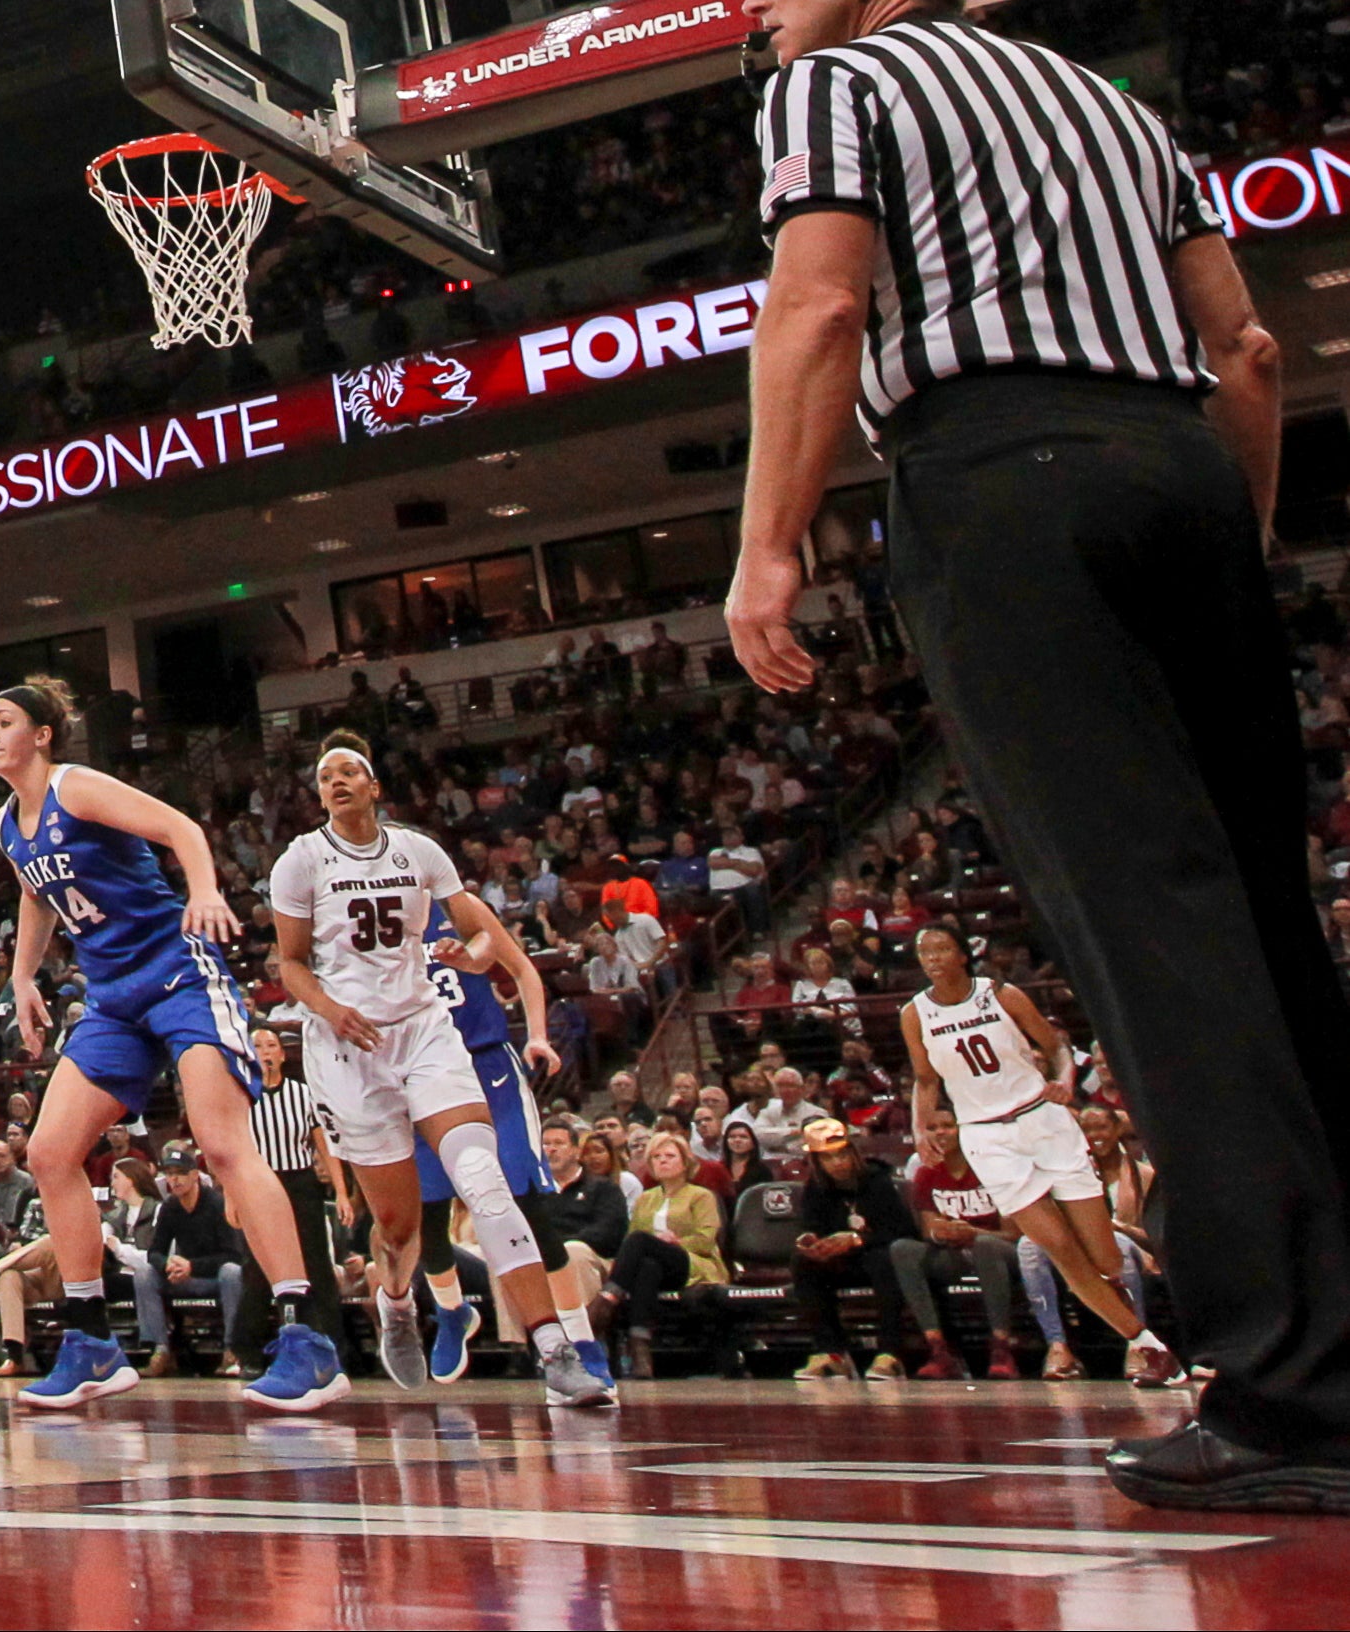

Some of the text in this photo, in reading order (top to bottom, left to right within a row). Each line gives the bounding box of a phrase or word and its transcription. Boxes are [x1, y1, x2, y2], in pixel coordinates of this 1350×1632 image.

[463, 41, 569, 85] UNDER
[331, 875, 417, 892] SOUTH CAROLINA
[47, 886, 106, 935] 14
[347, 896, 403, 952] 35
[930, 1013, 1001, 1037] SOUTH CAROLINA
[955, 1034, 1000, 1077] 10
